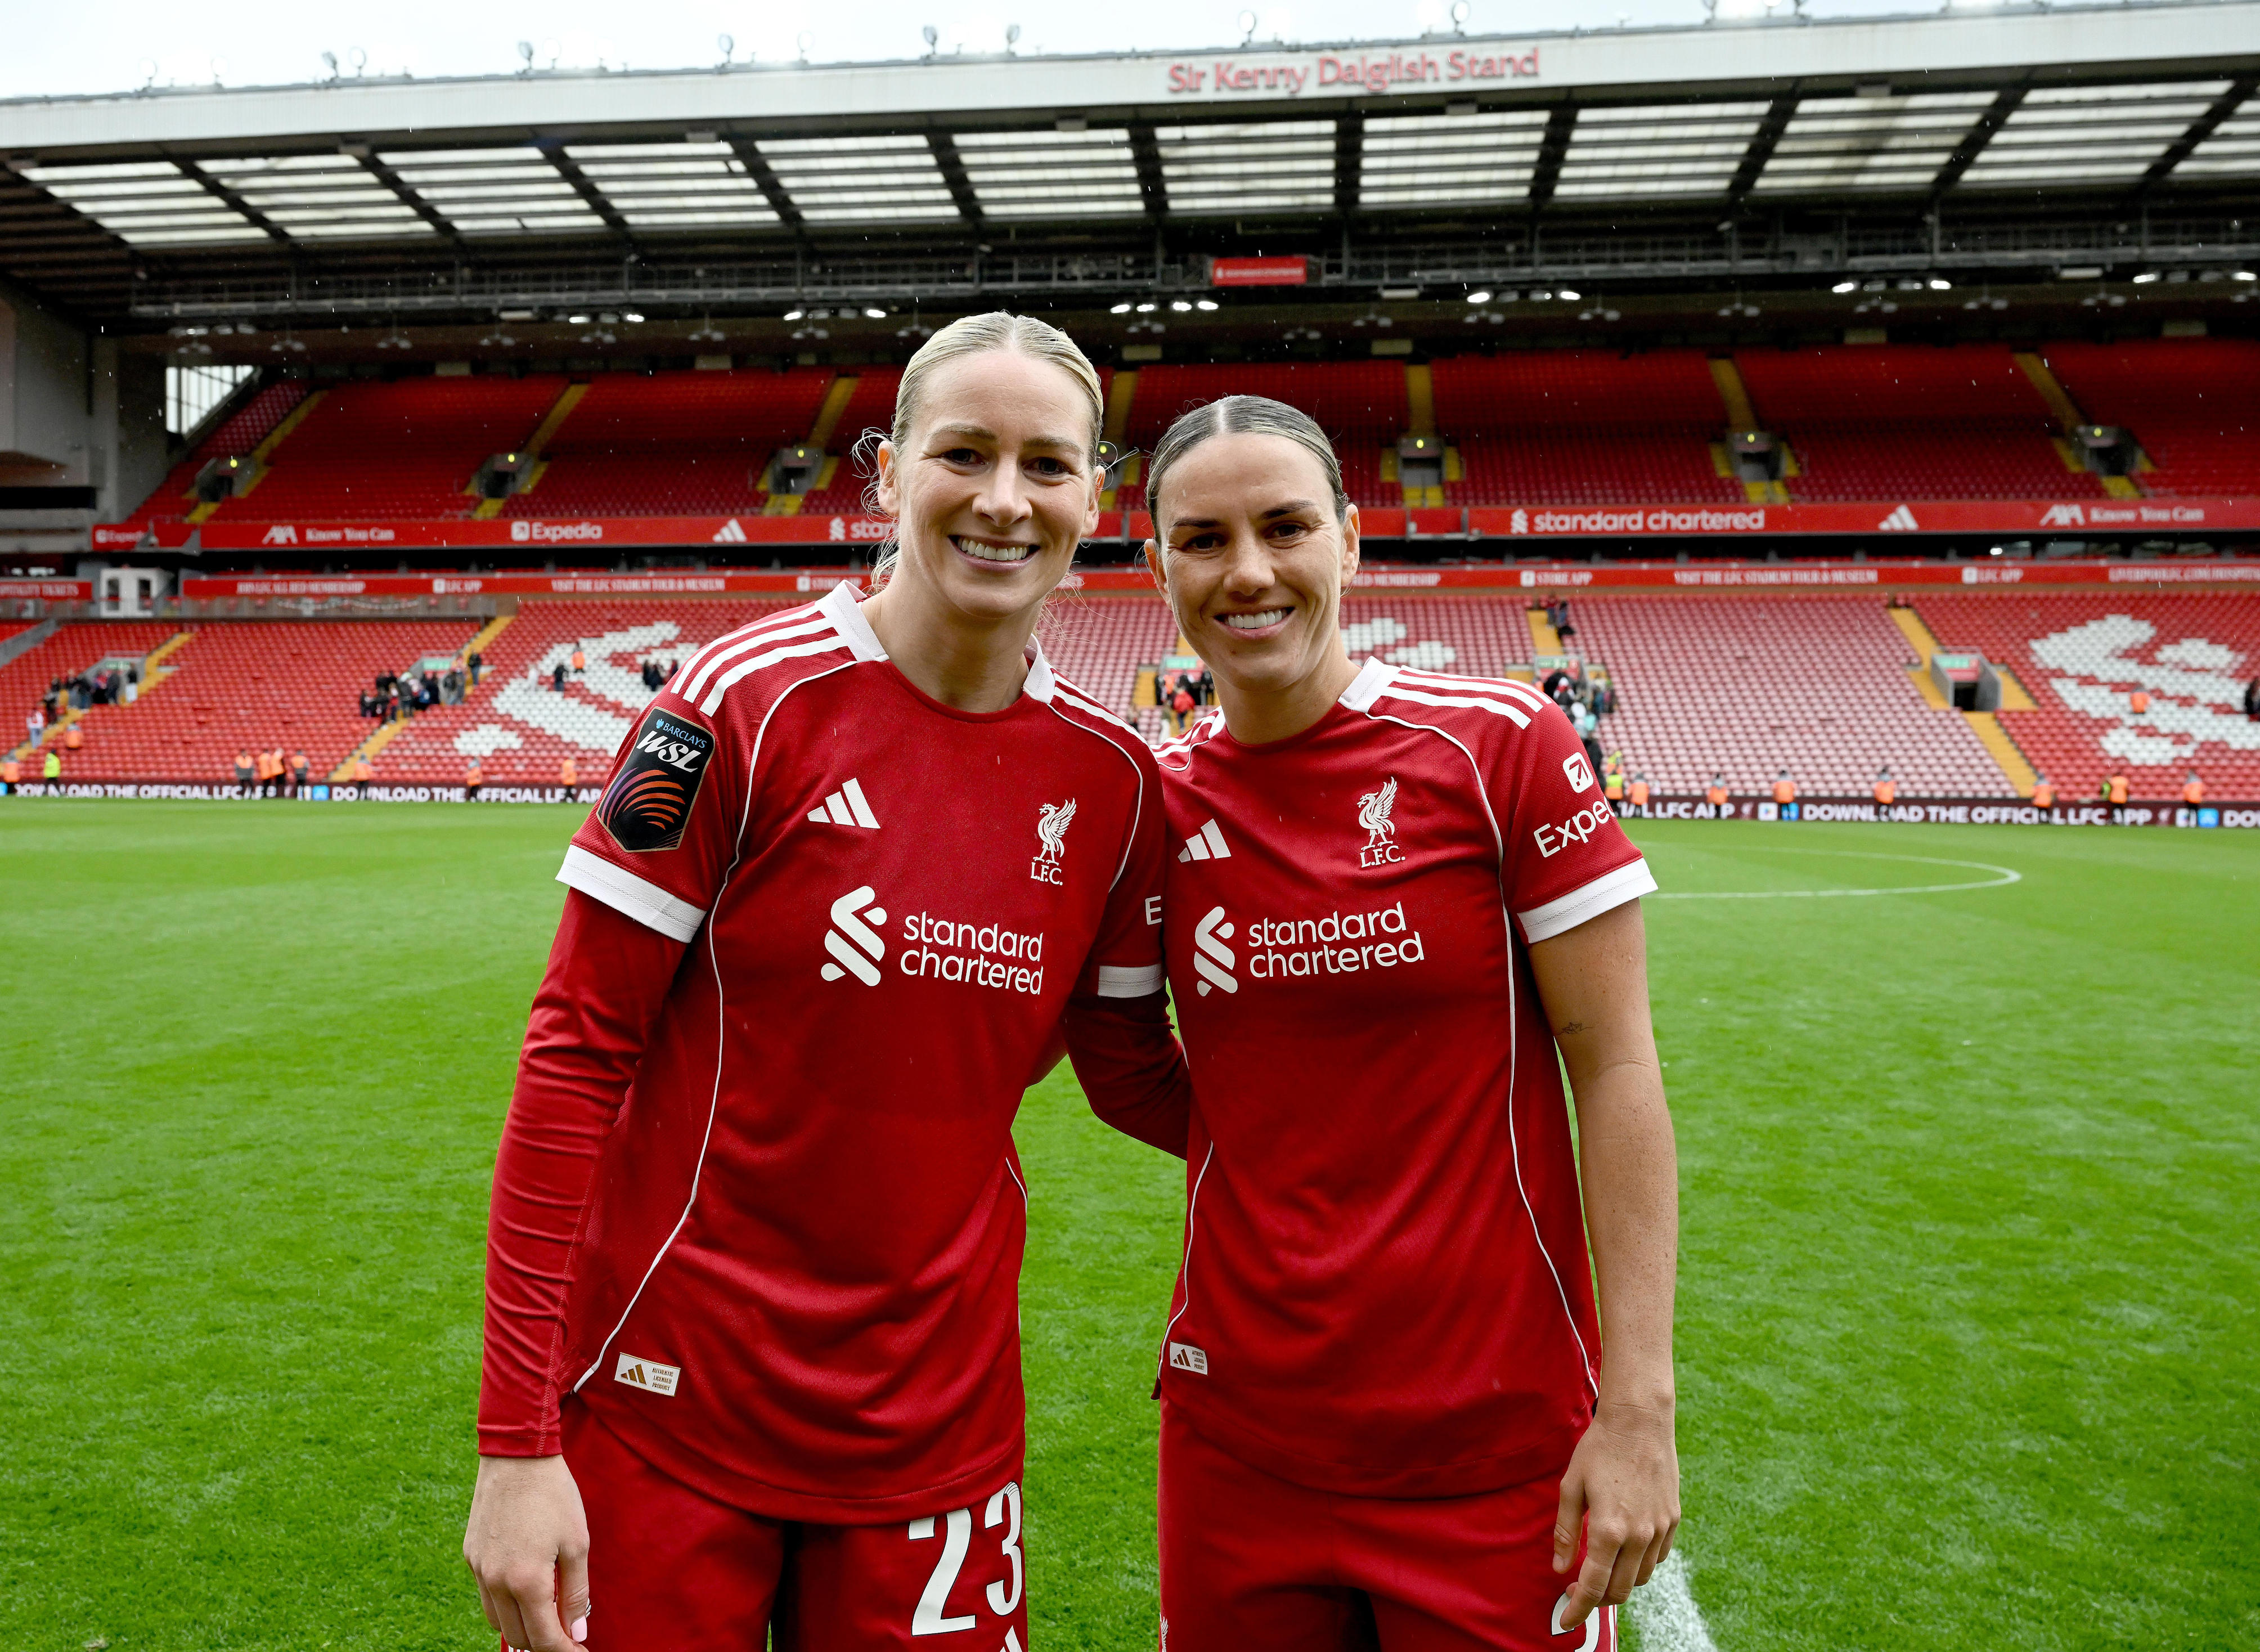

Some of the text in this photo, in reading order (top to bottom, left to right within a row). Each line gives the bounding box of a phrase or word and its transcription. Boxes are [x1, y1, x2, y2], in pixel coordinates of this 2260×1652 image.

[1169, 48, 1540, 94] Sir Kenny Dalglish Stand
[1534, 508, 1765, 532] standard chartered
[2091, 507, 2136, 523] Know
[2140, 506, 2171, 522] You
[2172, 505, 2205, 522] Can
[305, 527, 342, 541] Know
[343, 527, 369, 541] You
[369, 527, 394, 541] Can
[532, 522, 603, 542] Expedia
[663, 722, 707, 748] BARCLAYS
[636, 730, 702, 773] WSL
[105, 784, 138, 798] THE
[139, 784, 213, 800] OFFICIAL
[213, 785, 243, 800] LFC
[431, 787, 466, 803] THE
[470, 788, 544, 803] FFICIAL
[1655, 802, 1693, 819] LFC
[1803, 803, 1925, 822] DOWNLOAD
[1925, 805, 1969, 823] THE
[2067, 807, 2108, 826] LFC
[1360, 845, 1406, 869] L.F.C.
[1030, 861, 1063, 886] L.F.C.
[903, 911, 1044, 962] standard
[1248, 901, 1407, 948] standard
[1250, 931, 1425, 978] chartered
[900, 945, 1044, 995] chartered
[652, 1367, 674, 1377] AUTHENTIC
[653, 1375, 672, 1384] LICENSED
[652, 1382, 671, 1391] PRODUCT
[907, 1481, 1023, 1637] 23
